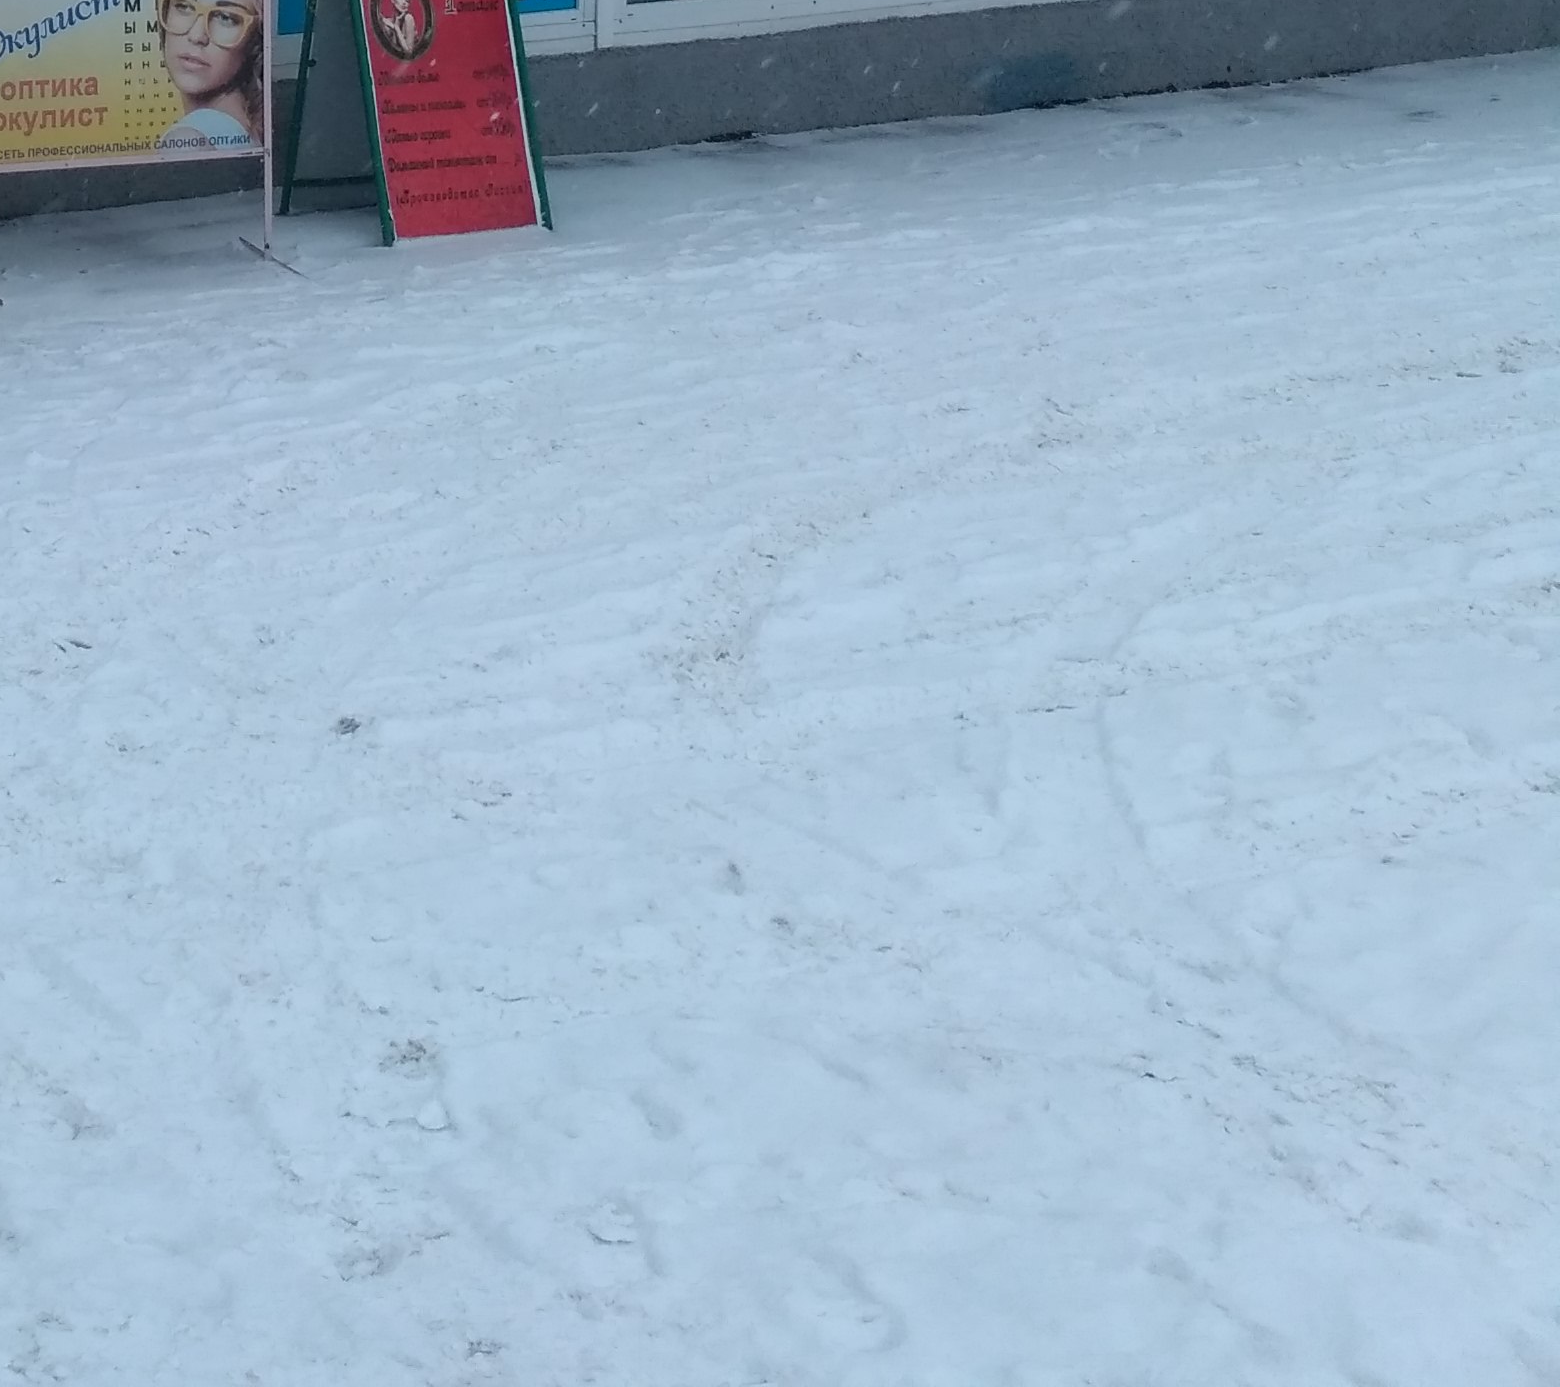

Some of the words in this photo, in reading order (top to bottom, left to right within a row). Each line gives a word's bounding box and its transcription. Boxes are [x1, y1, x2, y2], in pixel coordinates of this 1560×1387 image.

[0, 77, 99, 101] оптика
[28, 141, 151, 158] ПРОФЕССИОНАЛЬНЫХ
[154, 137, 206, 150] САЛОНОВ
[208, 134, 251, 147] ОПТИКИ
